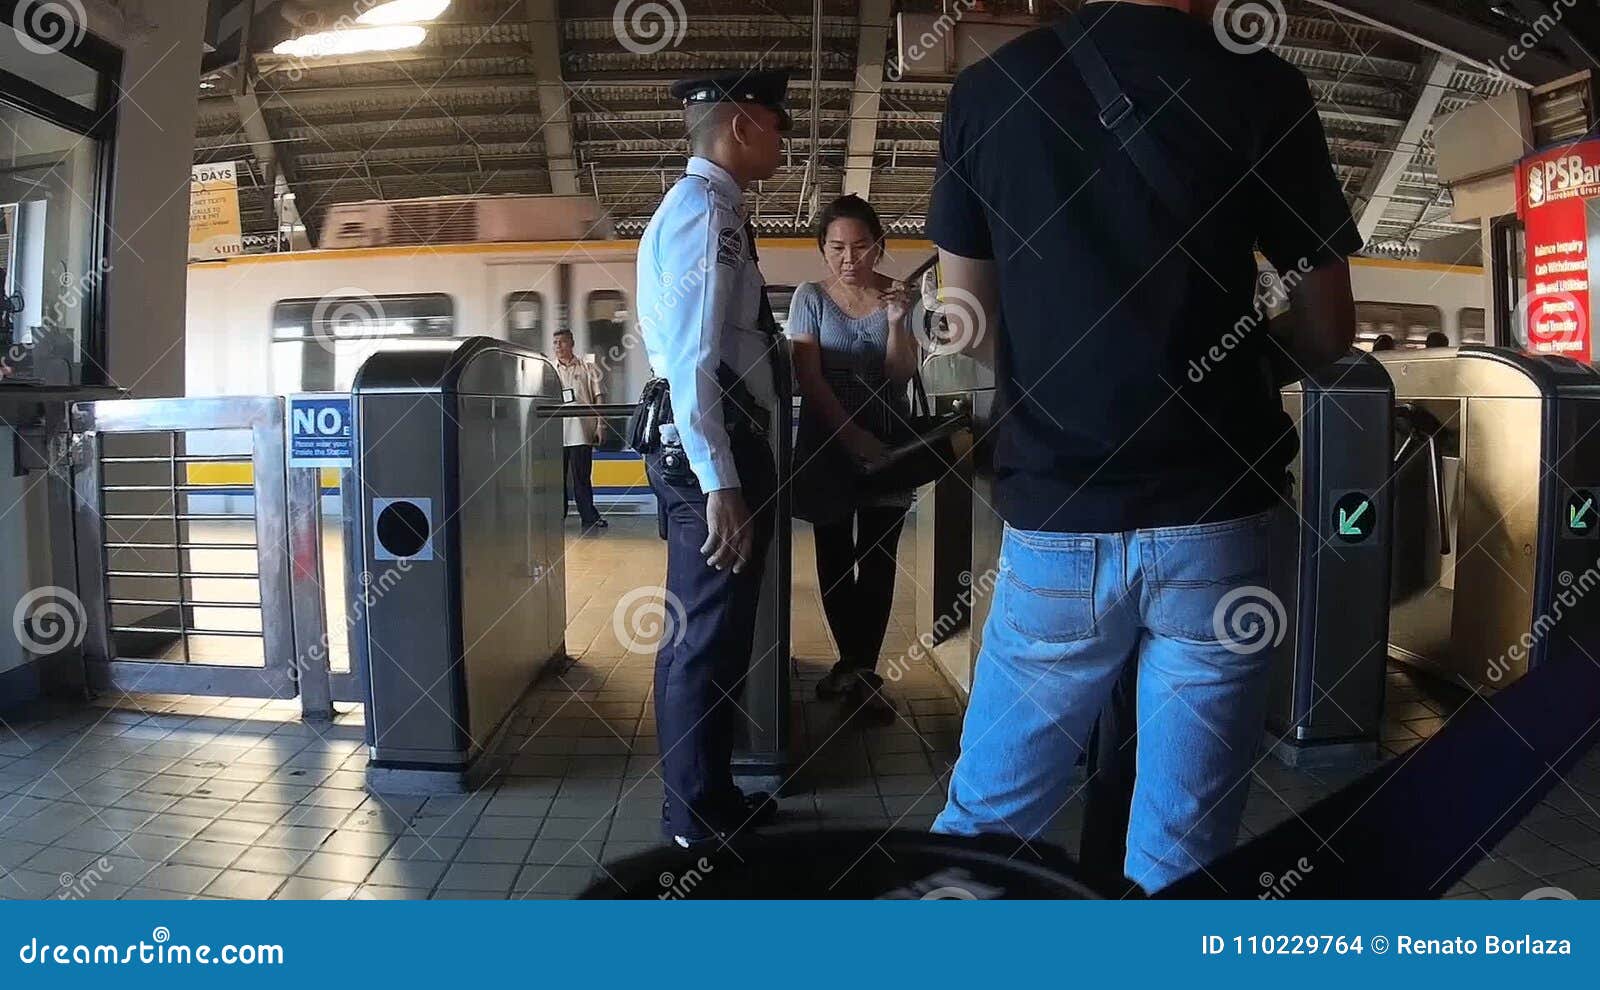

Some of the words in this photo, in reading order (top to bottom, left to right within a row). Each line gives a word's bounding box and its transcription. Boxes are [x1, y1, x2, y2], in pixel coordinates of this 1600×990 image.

[201, 170, 232, 181] DAYS
[214, 244, 240, 254] sun
[293, 407, 342, 435] NO
